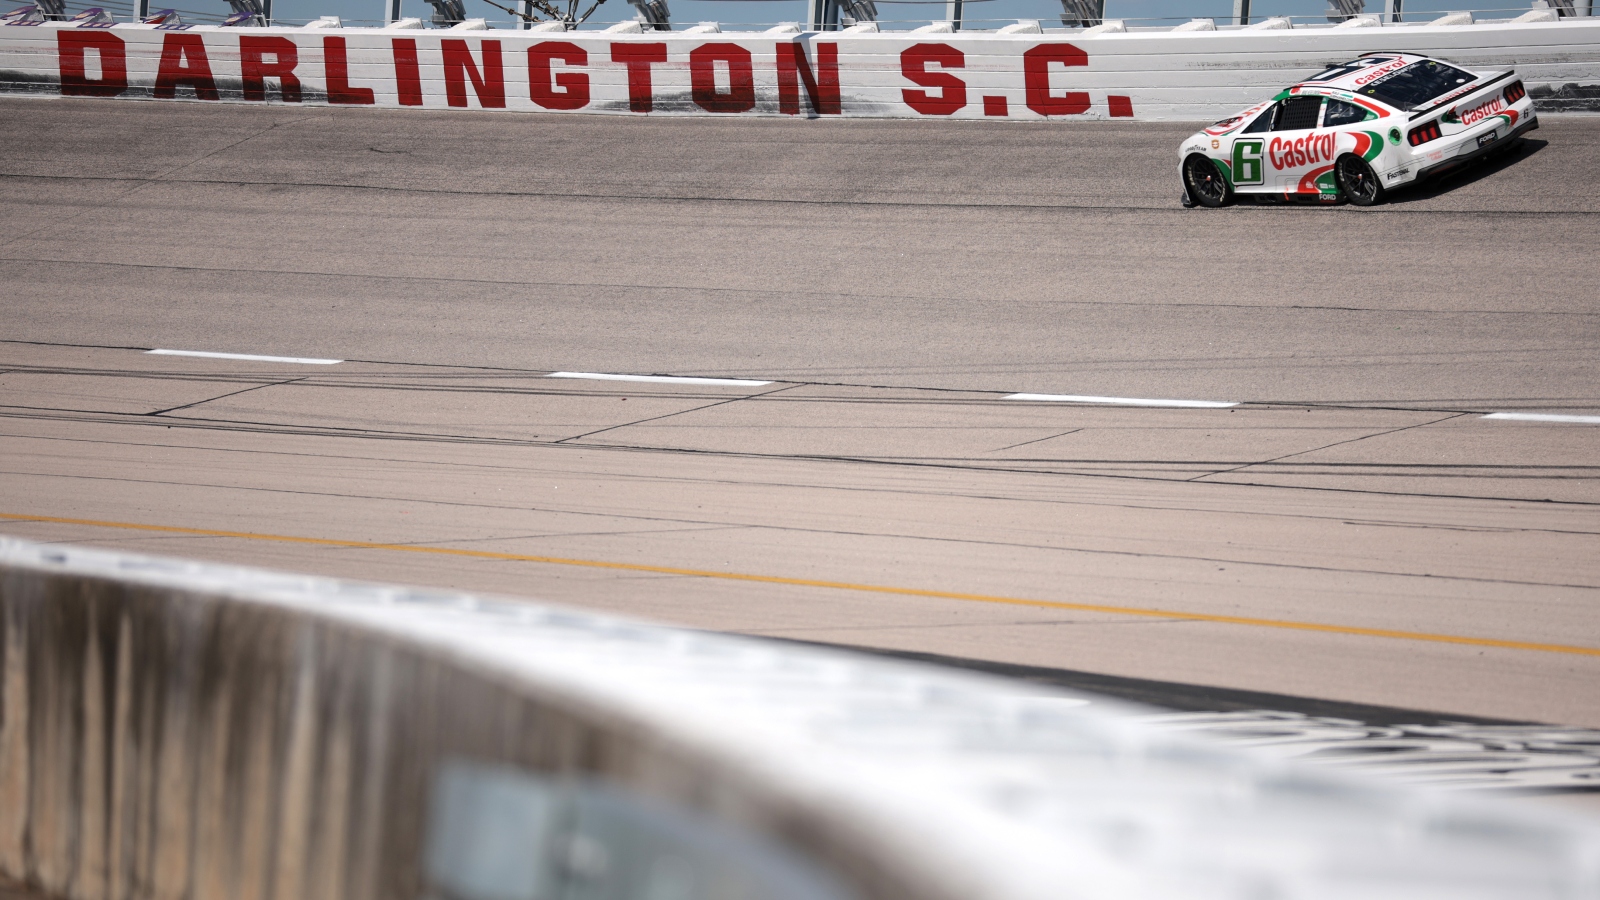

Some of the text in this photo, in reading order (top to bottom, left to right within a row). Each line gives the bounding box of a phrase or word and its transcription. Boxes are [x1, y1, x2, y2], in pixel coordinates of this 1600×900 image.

[57, 30, 1134, 118] DARLINGTON S.C.
[1355, 59, 1408, 85] Castrol
[1461, 95, 1503, 126] Castrol
[1523, 108, 1530, 119] 6
[1269, 131, 1337, 171] Castrol
[1479, 132, 1495, 144] FORD
[1232, 140, 1263, 183] 6
